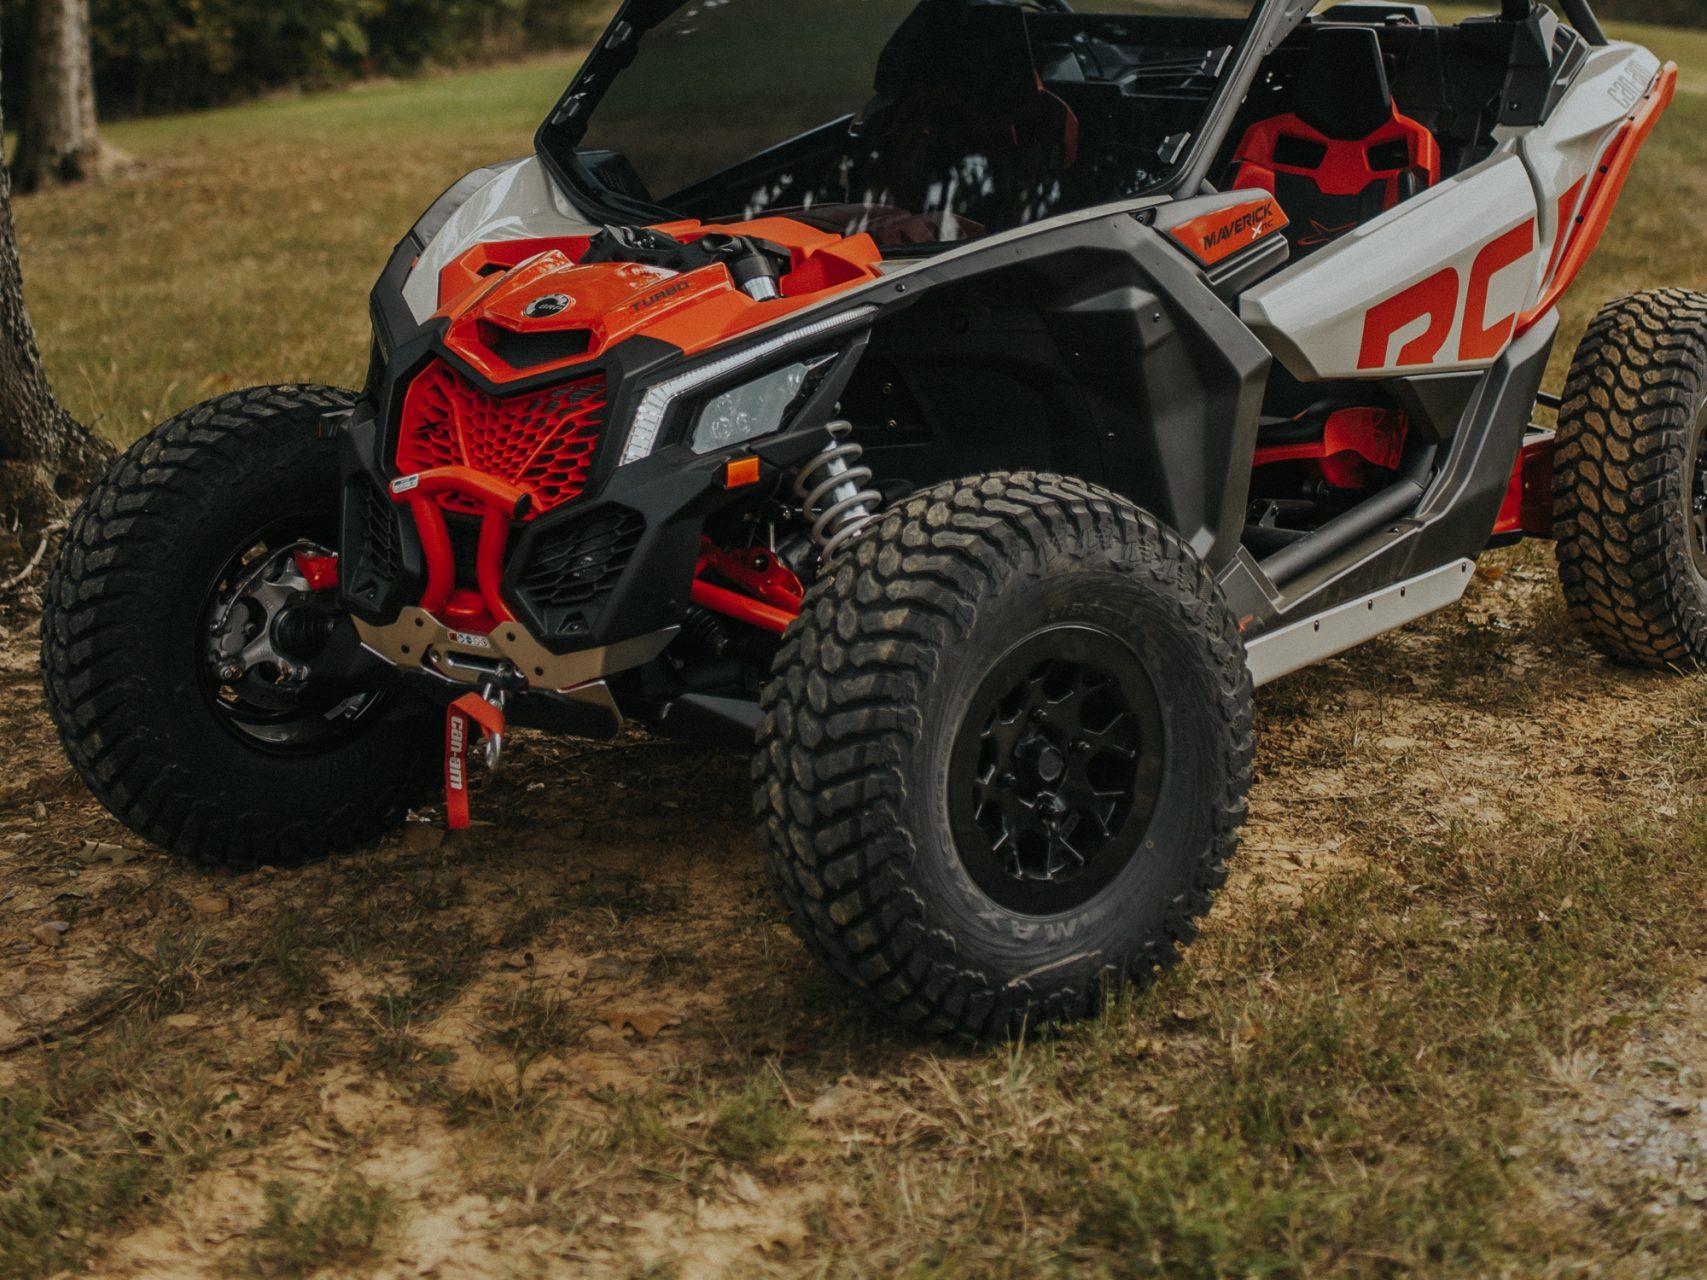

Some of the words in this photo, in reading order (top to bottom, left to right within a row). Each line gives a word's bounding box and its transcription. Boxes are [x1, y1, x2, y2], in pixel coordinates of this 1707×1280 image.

[1202, 201, 1273, 251] MAVERICK
[630, 280, 689, 311] TURBO
[1356, 216, 1536, 370] RC
